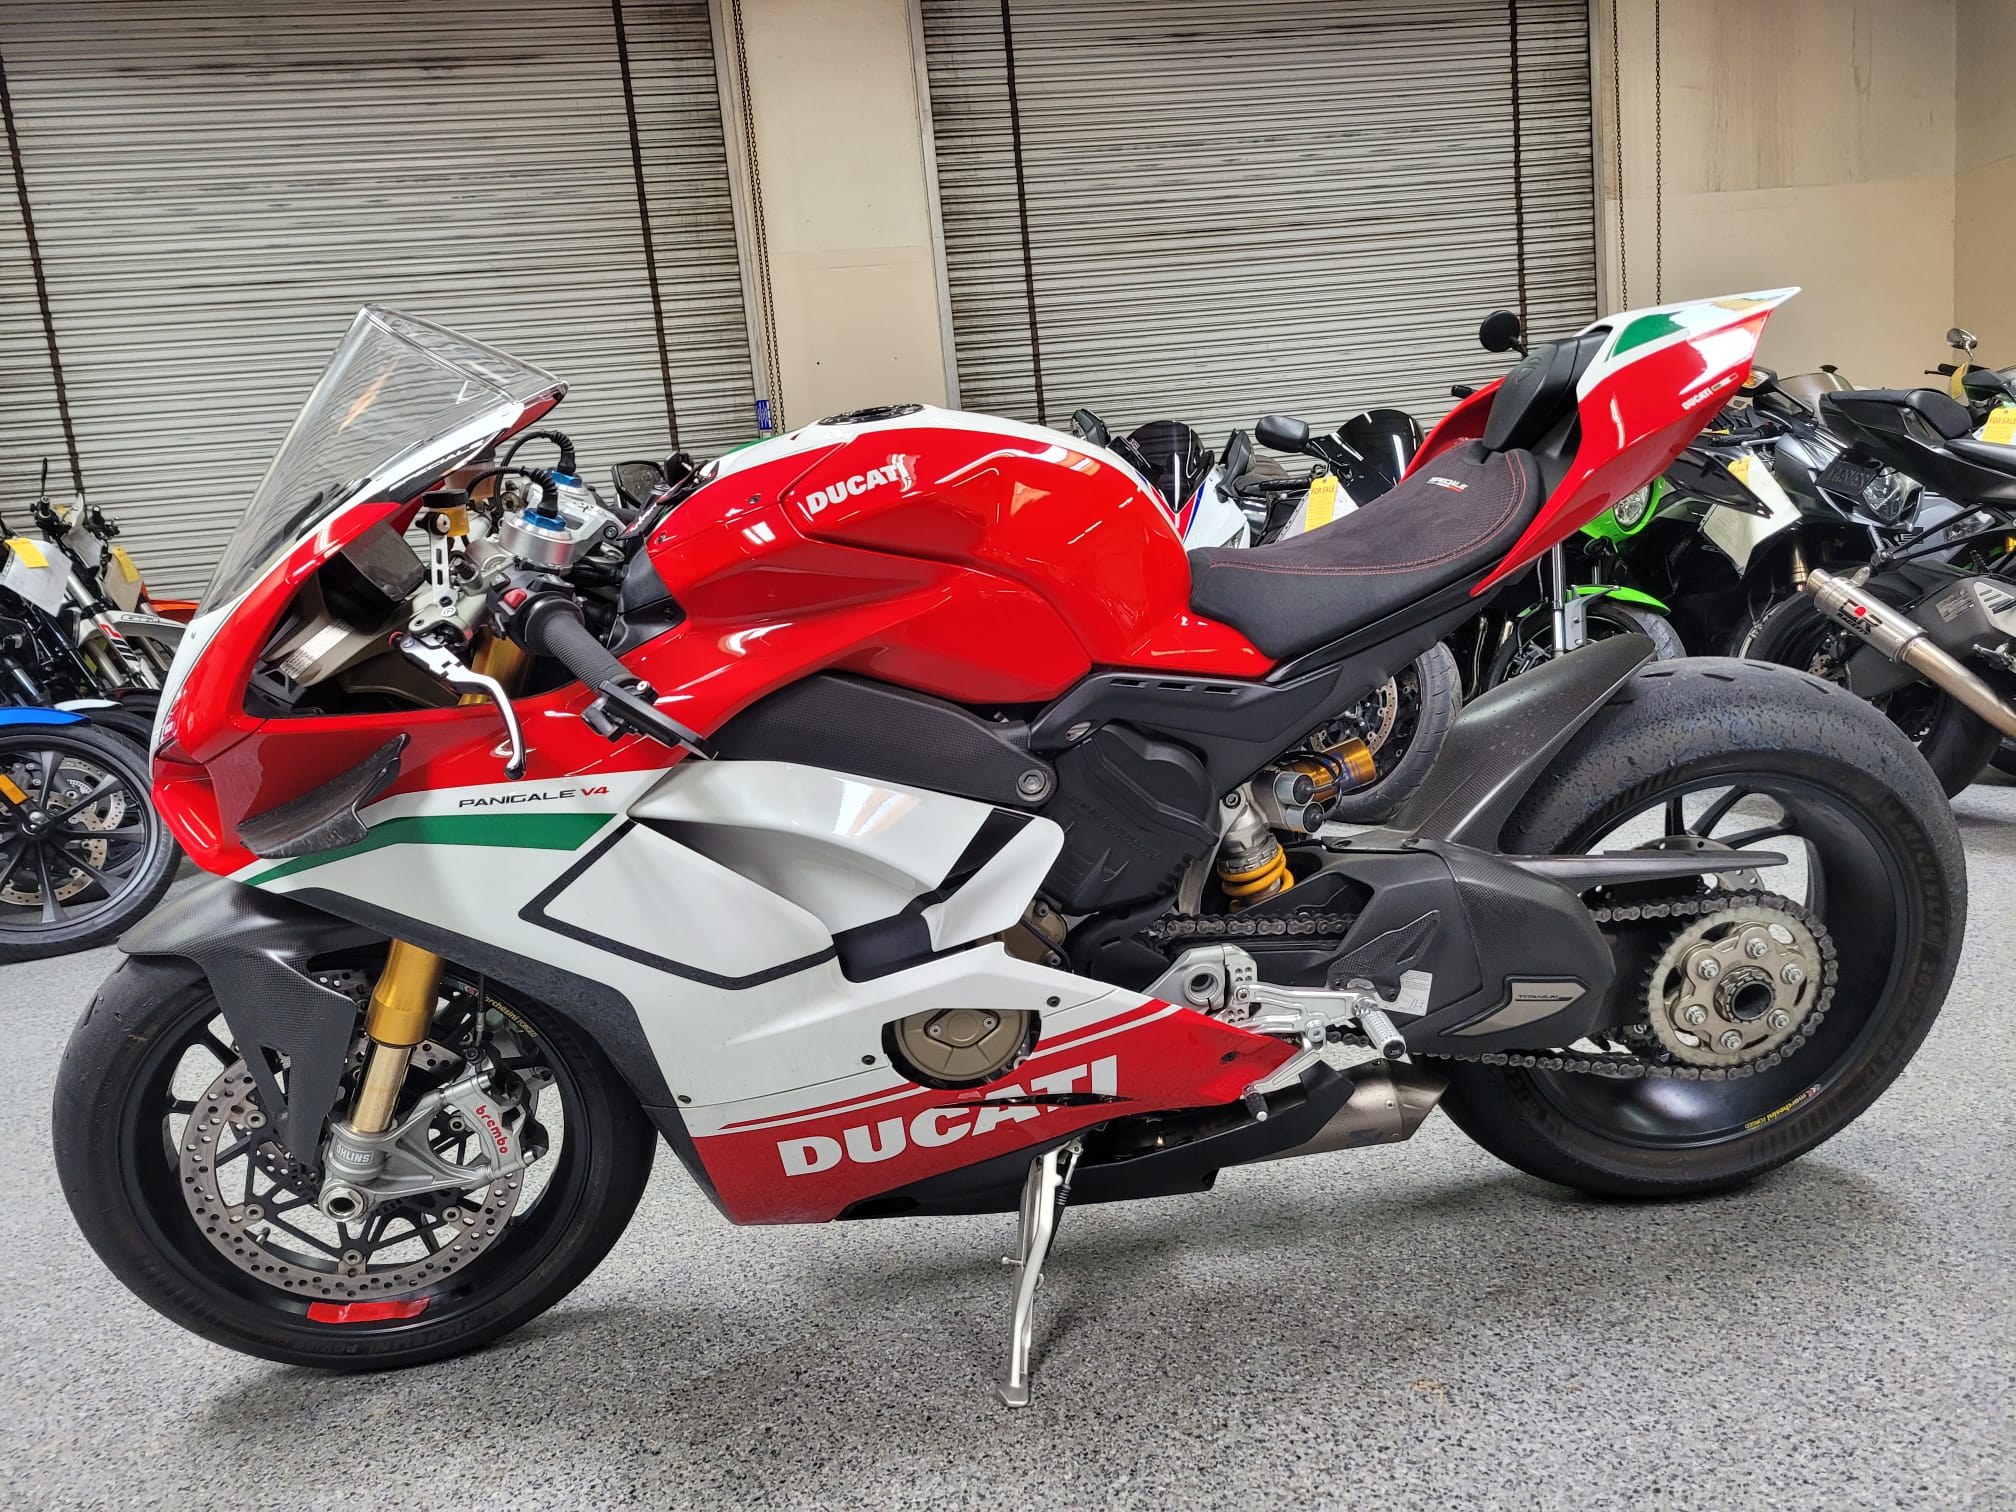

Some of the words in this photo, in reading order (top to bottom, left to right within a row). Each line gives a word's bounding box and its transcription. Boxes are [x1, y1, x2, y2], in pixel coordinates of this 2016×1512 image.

[1681, 387, 1714, 411] DUCATI
[805, 463, 910, 515] DUCATI
[458, 789, 577, 808] PANIGALE
[580, 786, 610, 796] V4
[475, 1104, 508, 1154] brembo
[777, 1054, 1118, 1177] DUCATI
